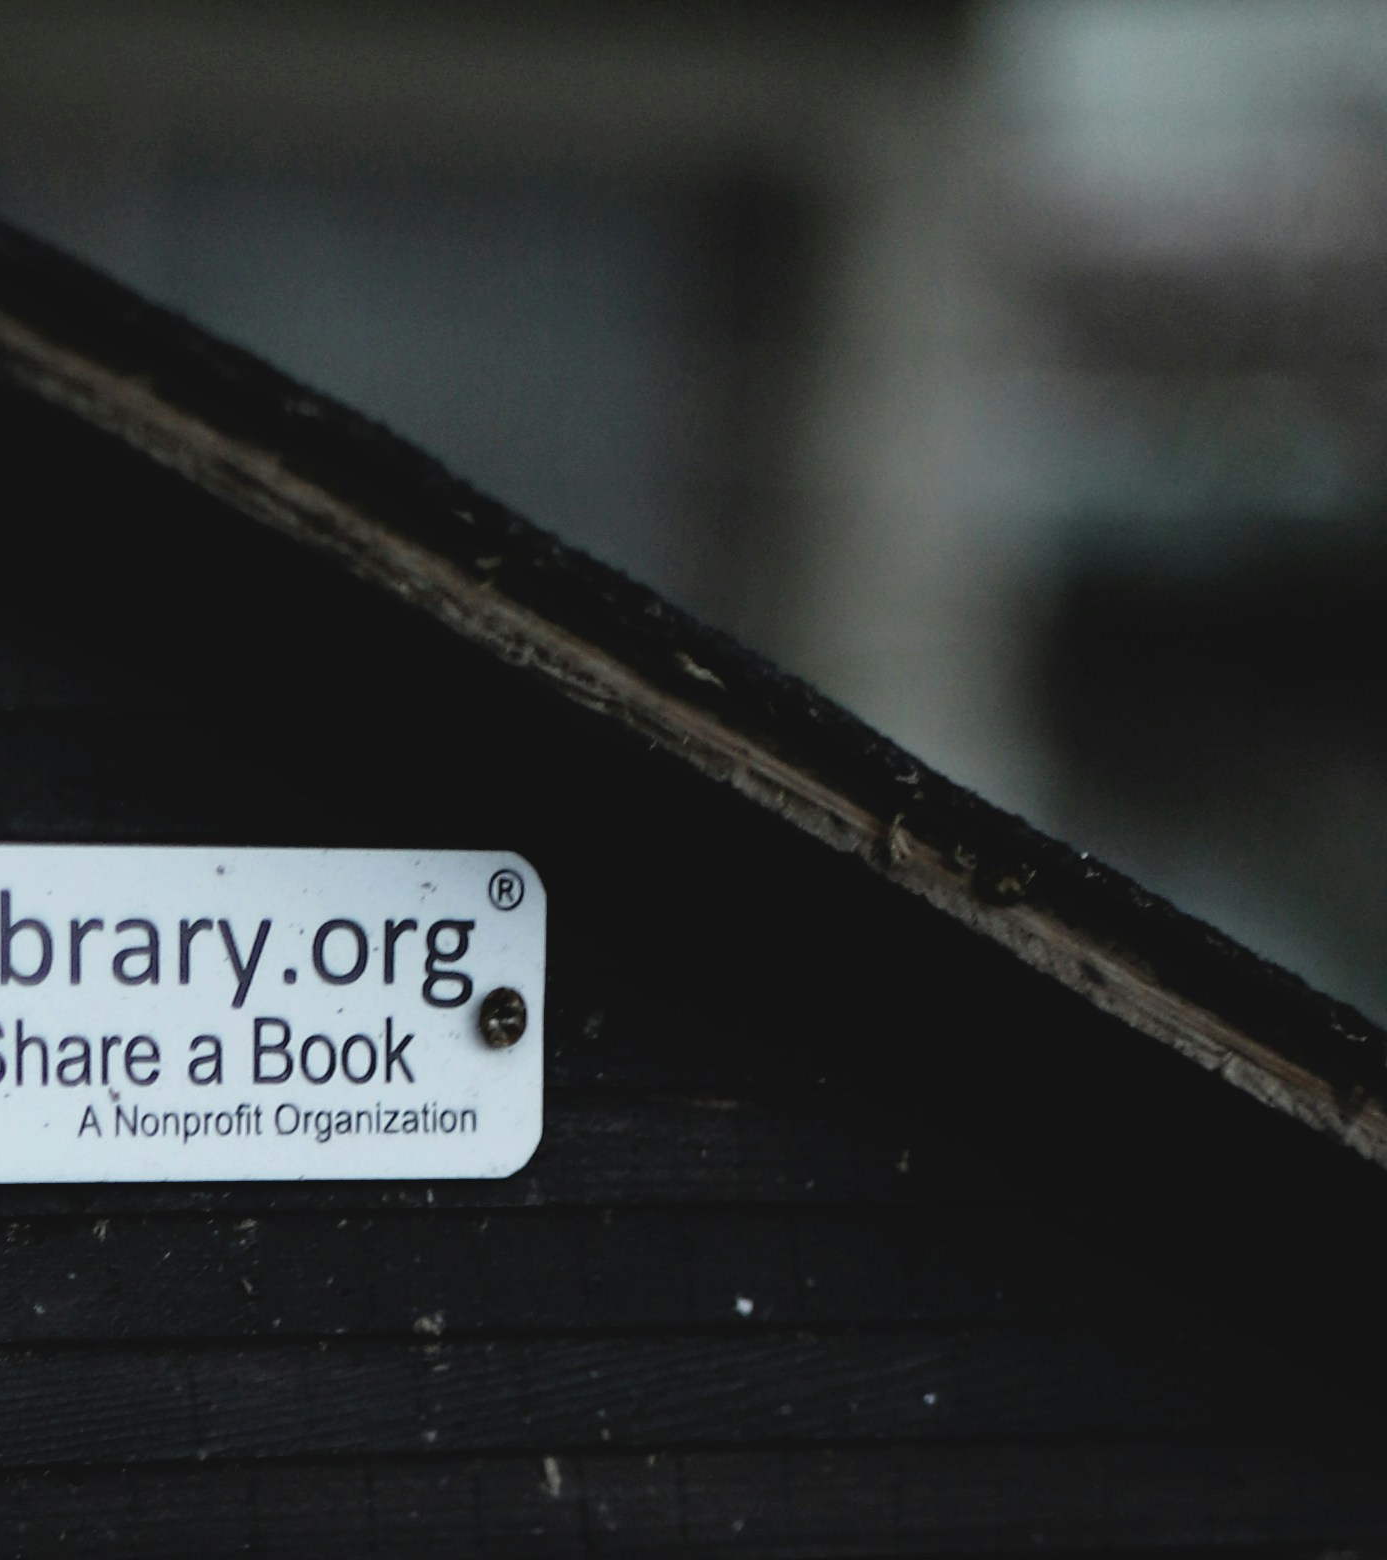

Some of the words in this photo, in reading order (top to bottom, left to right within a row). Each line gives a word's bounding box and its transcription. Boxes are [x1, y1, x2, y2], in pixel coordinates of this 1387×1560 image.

[188, 1032, 224, 1086] a
[253, 1017, 415, 1085] Book
[78, 1106, 102, 1138] A
[115, 1103, 263, 1143] Nonprofit
[274, 1102, 478, 1143] Organization
